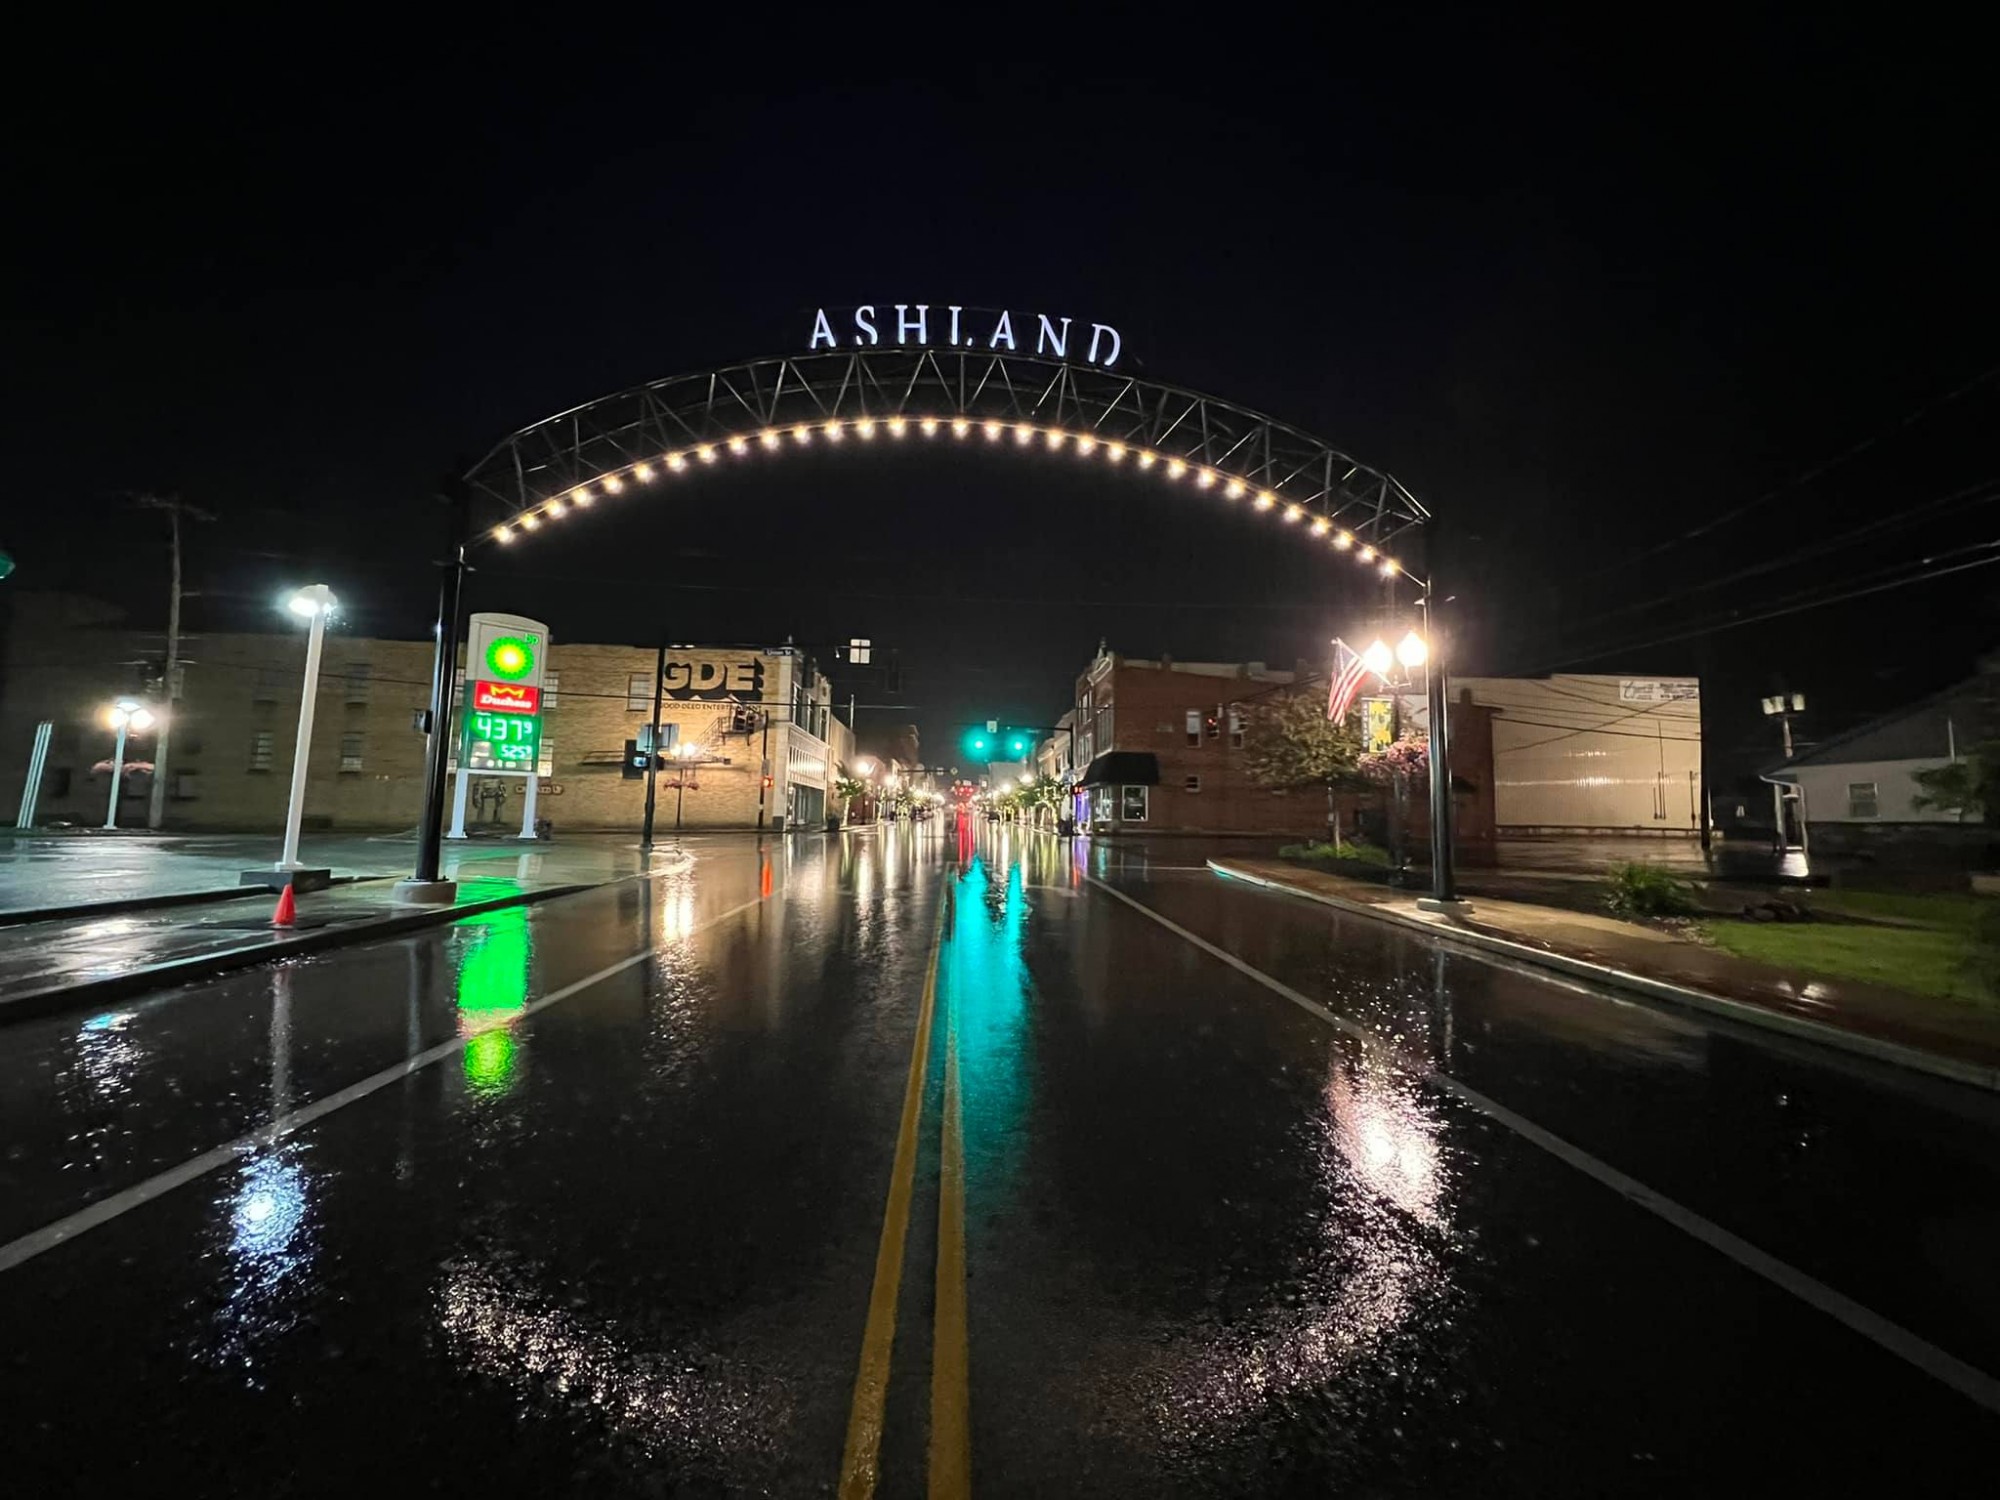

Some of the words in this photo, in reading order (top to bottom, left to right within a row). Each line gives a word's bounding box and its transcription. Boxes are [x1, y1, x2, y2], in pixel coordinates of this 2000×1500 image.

[810, 304, 1122, 366] ASHLAND
[524, 634, 538, 646] bp
[663, 660, 762, 699] GDE
